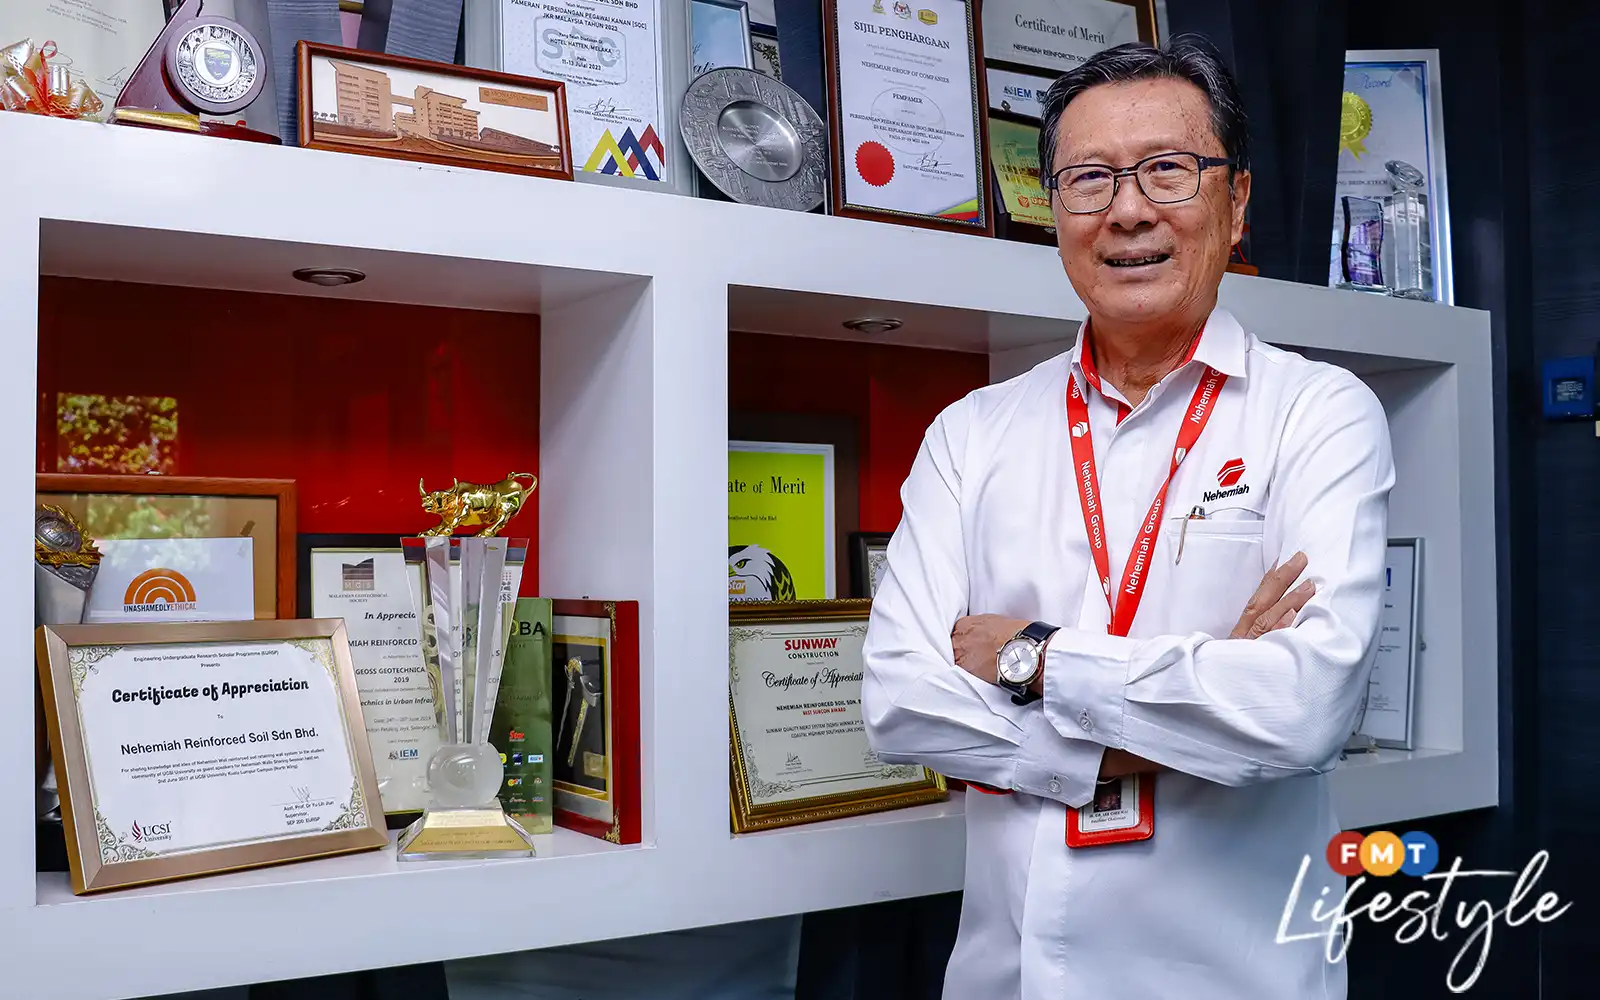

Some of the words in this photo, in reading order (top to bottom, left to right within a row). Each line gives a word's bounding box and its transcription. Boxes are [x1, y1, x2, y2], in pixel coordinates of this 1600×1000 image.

[511, 0, 540, 9] PAMERAN
[543, 3, 584, 17] PERSIDANGAN
[585, 12, 610, 21] PEGAWAI
[611, 16, 631, 25] KANAN
[625, 1, 638, 9] BHD
[555, 15, 583, 26] MALAYSIA
[585, 20, 604, 29] TAHUN
[1015, 14, 1066, 37] Certificate
[1068, 26, 1078, 38] of
[1079, 27, 1105, 44] Merit
[854, 21, 878, 34] SIJIL
[878, 26, 950, 49] PENGHARGAAN
[1013, 43, 1042, 56] NEHEMIAH
[1043, 48, 1075, 61] REINFORCED
[861, 60, 891, 72] NEHEMIAH
[892, 67, 911, 76] GROUP
[911, 70, 919, 78] OF
[919, 72, 950, 83] COMPANIES
[1358, 73, 1392, 89] Record
[1014, 87, 1032, 98] IEM
[1190, 378, 1218, 424] Nehemiah
[728, 479, 746, 492] ate
[752, 481, 763, 493] of
[770, 476, 806, 494] Merit
[1203, 484, 1249, 503] Nehemiah
[1082, 461, 1098, 513] Nehemiah
[1090, 515, 1102, 549] Group
[1125, 537, 1151, 595] Nehemiah
[1144, 499, 1162, 534] Group
[124, 603, 197, 612] UNASHAMEDLYETHICAL
[364, 612, 374, 620] In
[376, 611, 416, 620] Apprecia
[511, 620, 546, 636] OBA
[349, 639, 369, 647] MIAH
[371, 638, 418, 646] REINFORCED
[785, 638, 838, 651] SUNWAY
[788, 651, 839, 660] CONSTRUCTION
[356, 667, 378, 675] GEOSS
[380, 666, 425, 674] GEOTECHNICA
[762, 671, 809, 691] Certificate
[810, 672, 819, 689] of
[819, 667, 864, 688] Appreciati
[112, 687, 199, 706] Certificate
[202, 686, 219, 701] of
[221, 677, 309, 698] Appreciation
[776, 703, 803, 711] NEHEMIAH
[803, 701, 834, 709] REINFORCED
[120, 740, 181, 755] Nehemiah
[184, 734, 246, 750] Reinforced
[248, 731, 269, 745] Soil
[271, 729, 292, 742] Sdn
[294, 727, 319, 739] Bhd.
[509, 730, 525, 739] Star
[400, 749, 418, 758] IEM
[142, 823, 171, 837] UCSI
[144, 832, 172, 843] University
